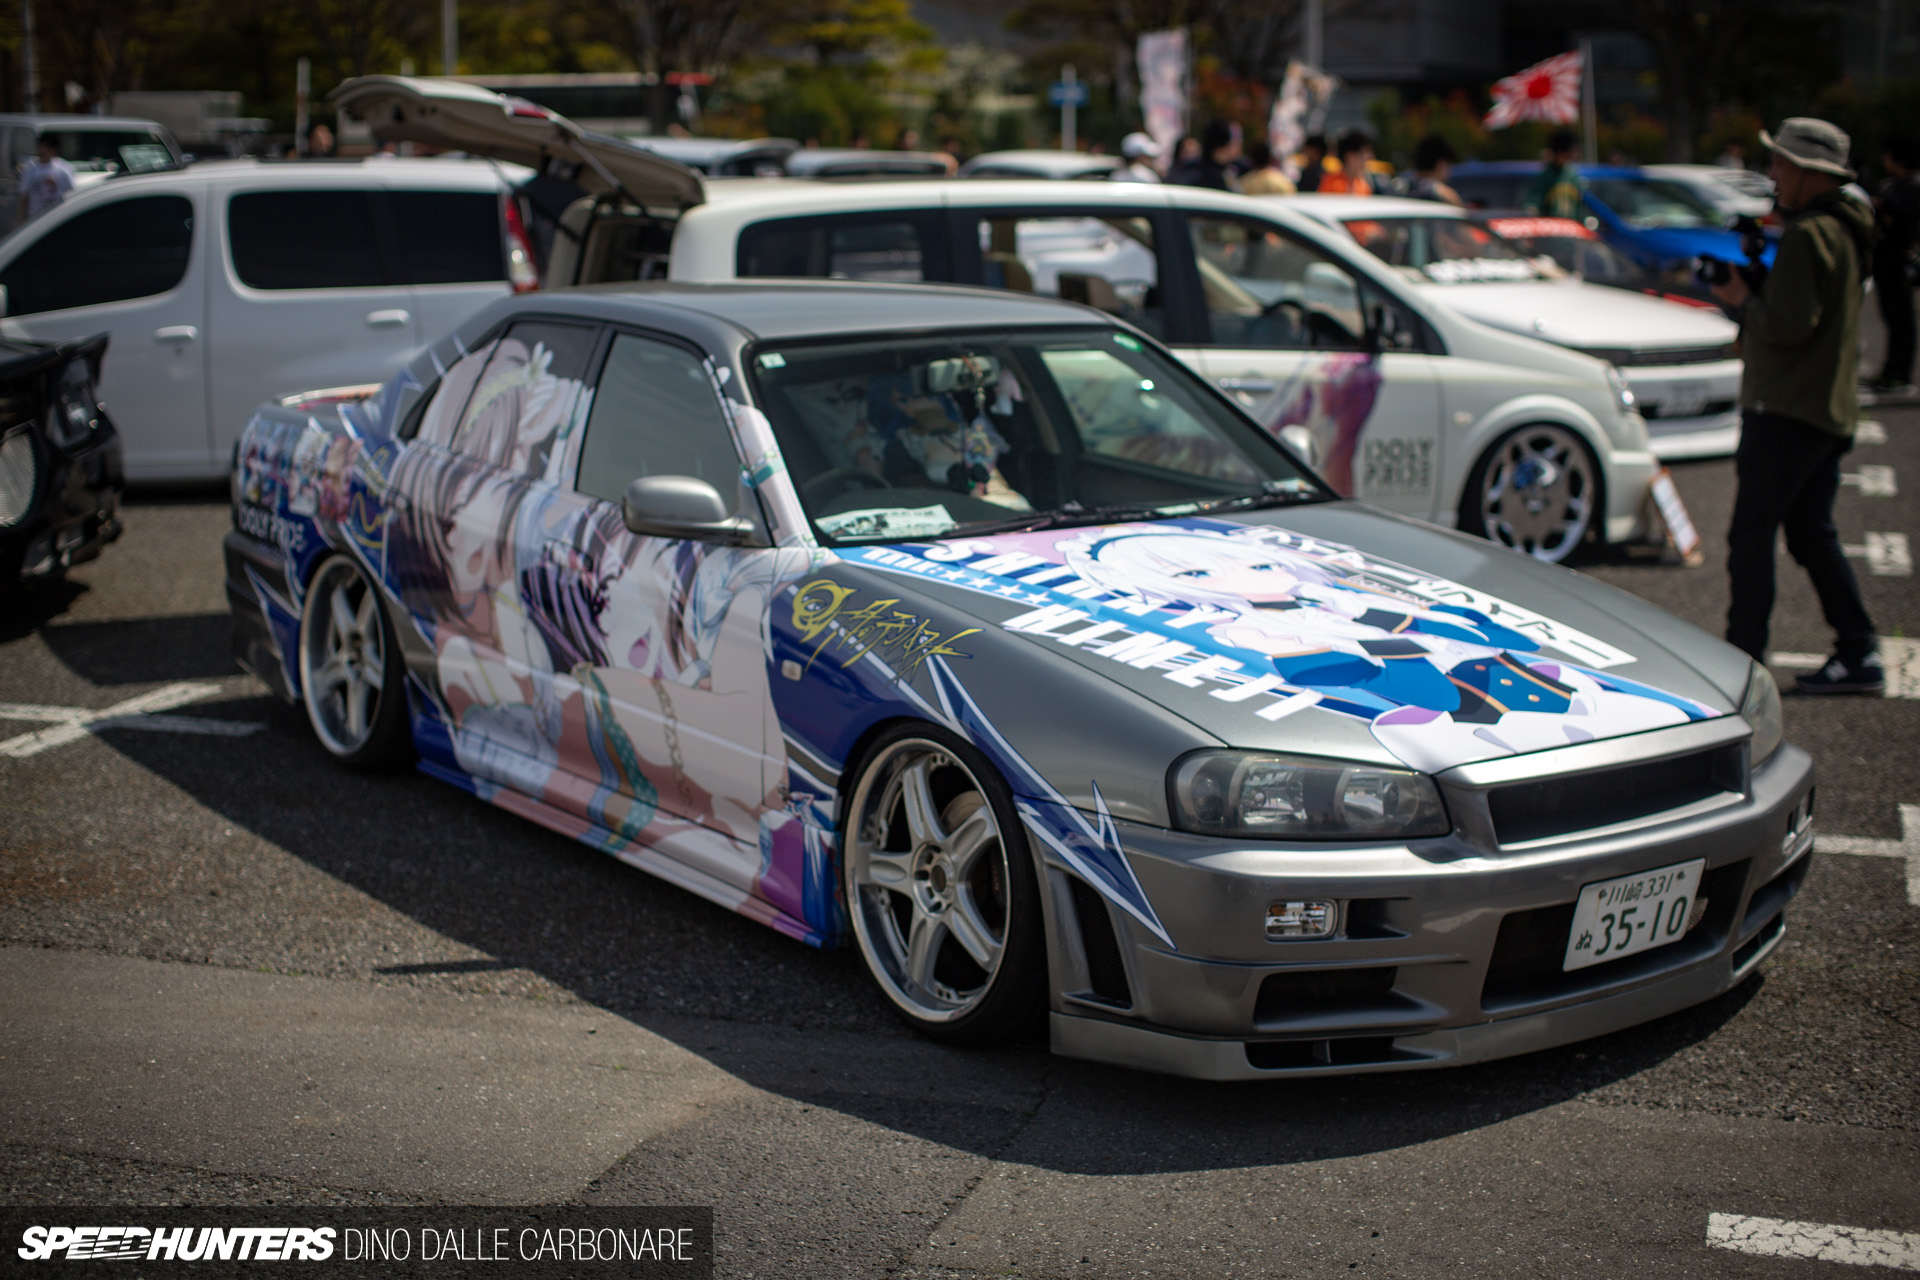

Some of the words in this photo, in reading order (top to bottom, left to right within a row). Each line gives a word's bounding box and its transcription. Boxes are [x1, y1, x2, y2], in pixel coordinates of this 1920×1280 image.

[1001, 603, 1324, 721] HIMEJI
[1606, 881, 1644, 907] 川崎
[1643, 873, 1675, 899] 331
[1575, 929, 1593, 951] ぬ
[1594, 895, 1688, 957] 35-10
